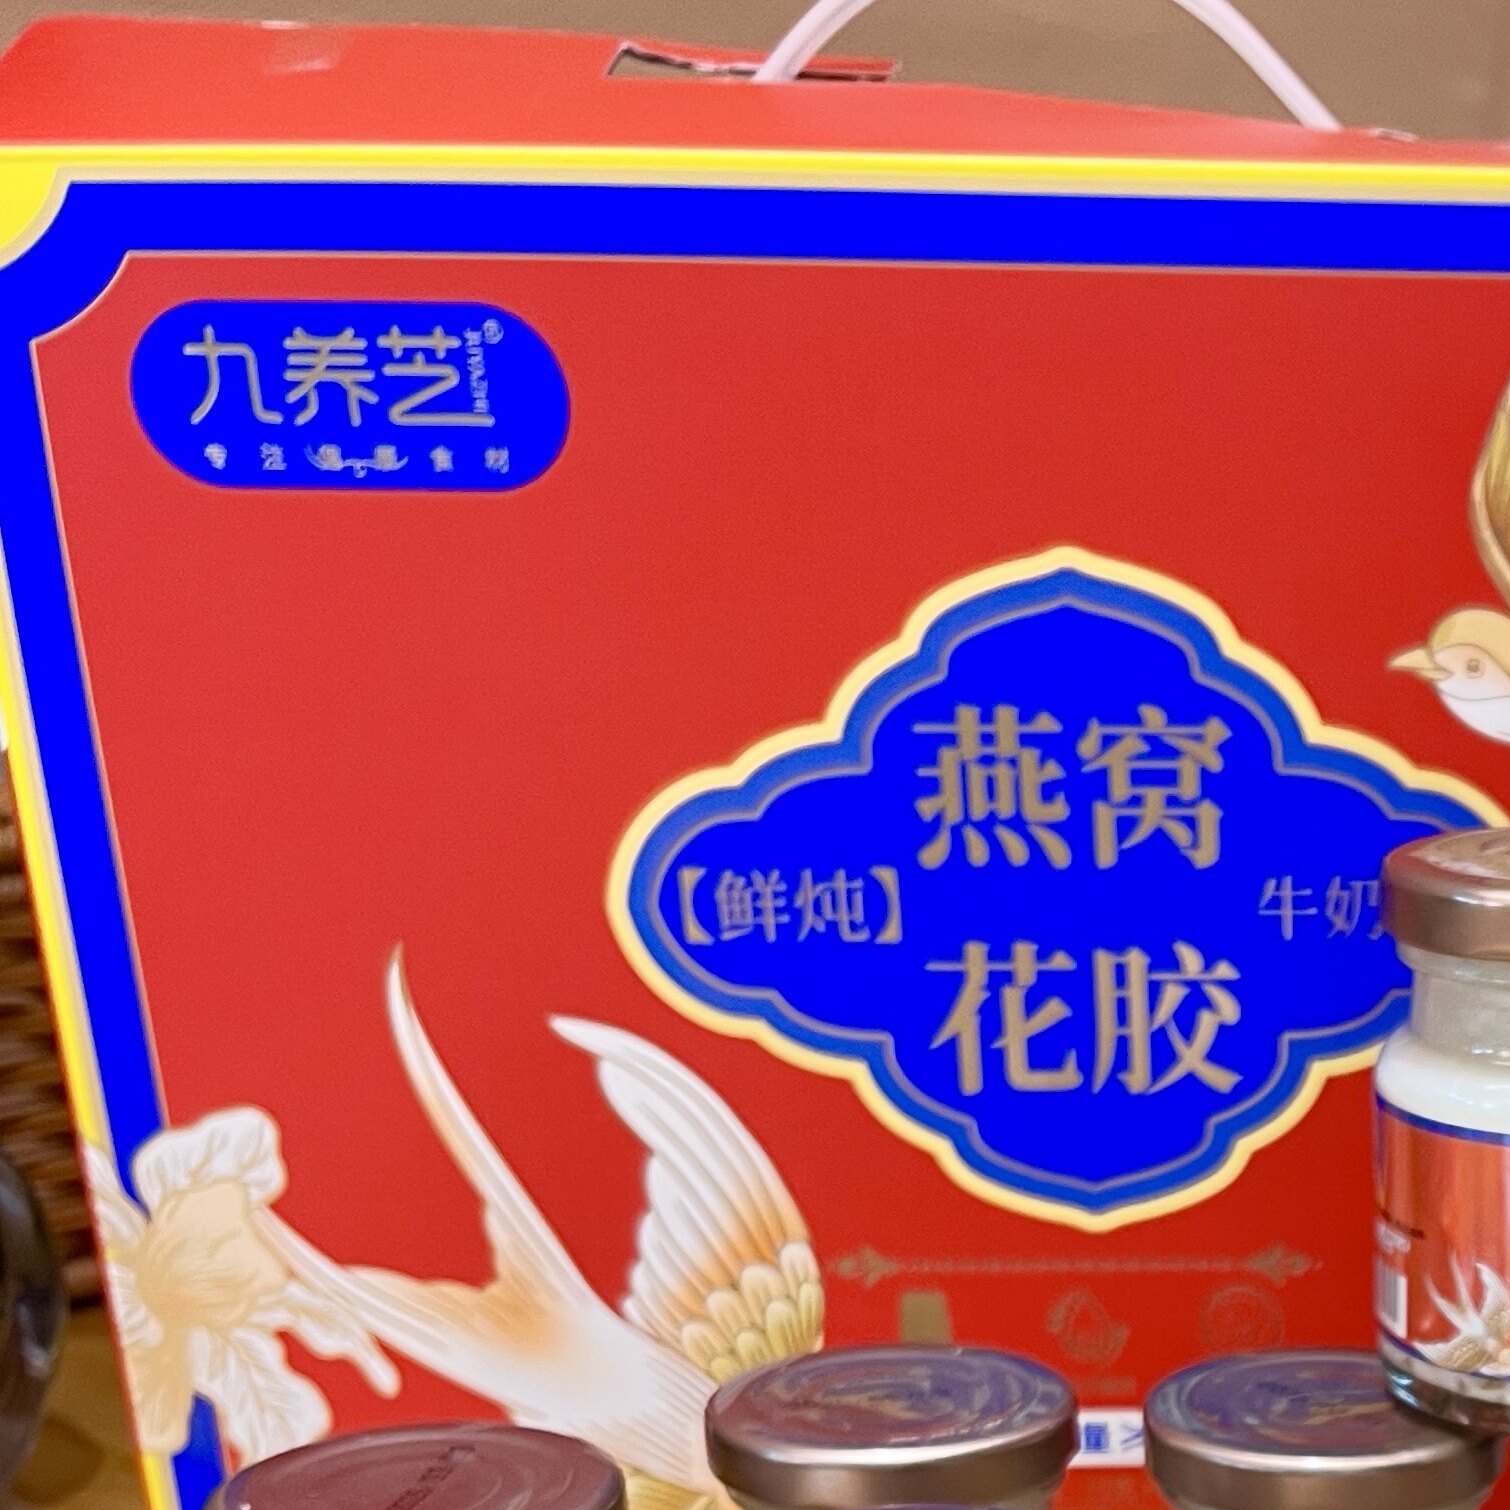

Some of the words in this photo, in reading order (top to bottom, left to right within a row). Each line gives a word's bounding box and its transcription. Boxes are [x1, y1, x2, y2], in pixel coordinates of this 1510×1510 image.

[182, 322, 496, 428] 九养芝
[911, 703, 1234, 871] 燕窝
[925, 940, 1243, 1097] 花胶
